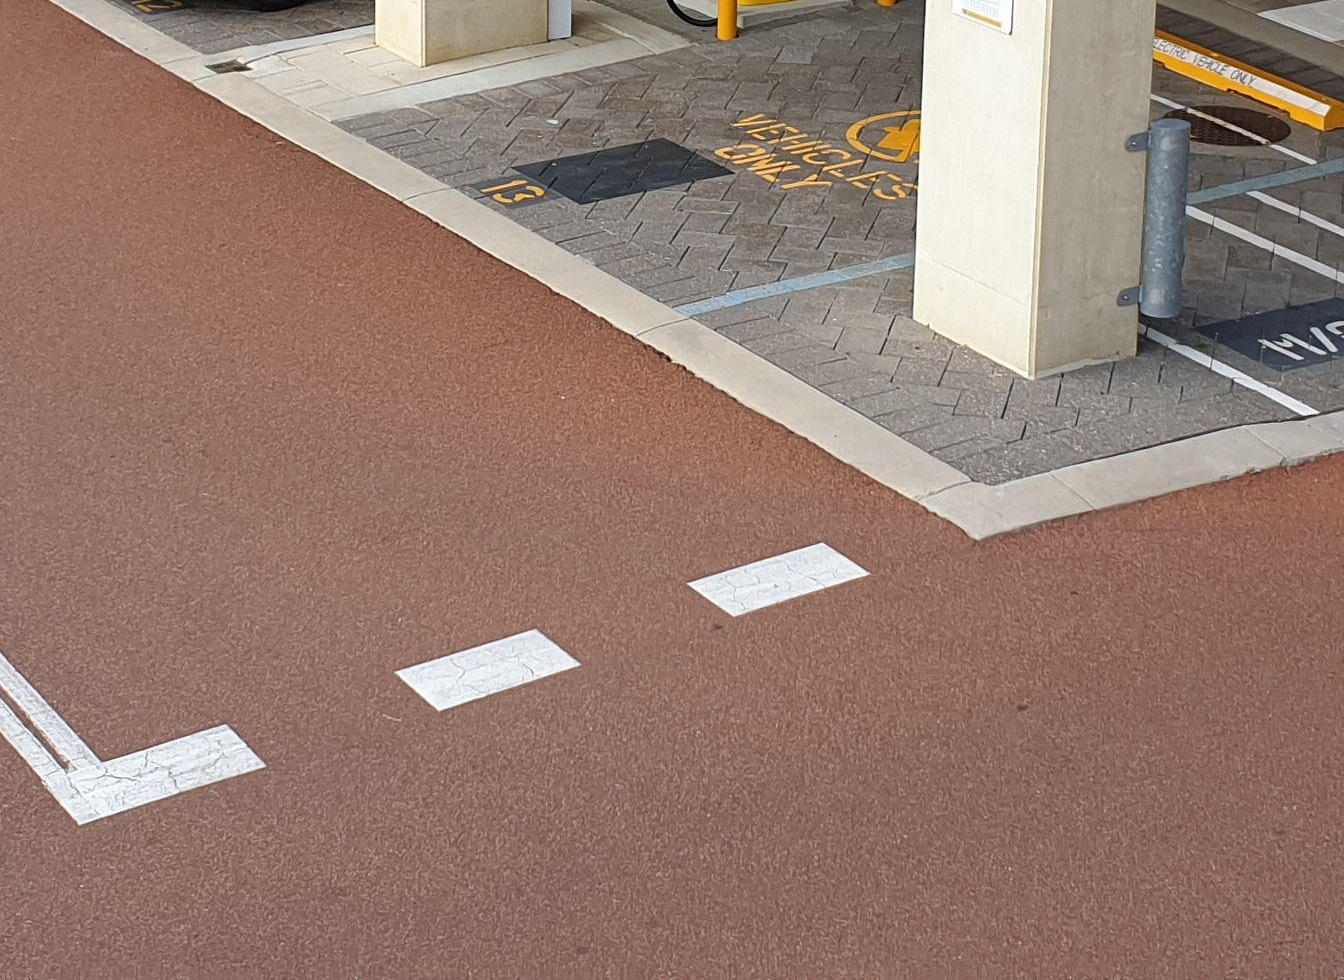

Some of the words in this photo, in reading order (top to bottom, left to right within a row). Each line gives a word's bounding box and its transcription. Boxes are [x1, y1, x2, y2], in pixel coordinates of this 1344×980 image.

[1192, 54, 1230, 76] VEHICLE
[1230, 69, 1257, 86] ONLY
[713, 143, 834, 190] ONLY
[730, 113, 919, 201] VEHICLES
[480, 179, 545, 204] 13
